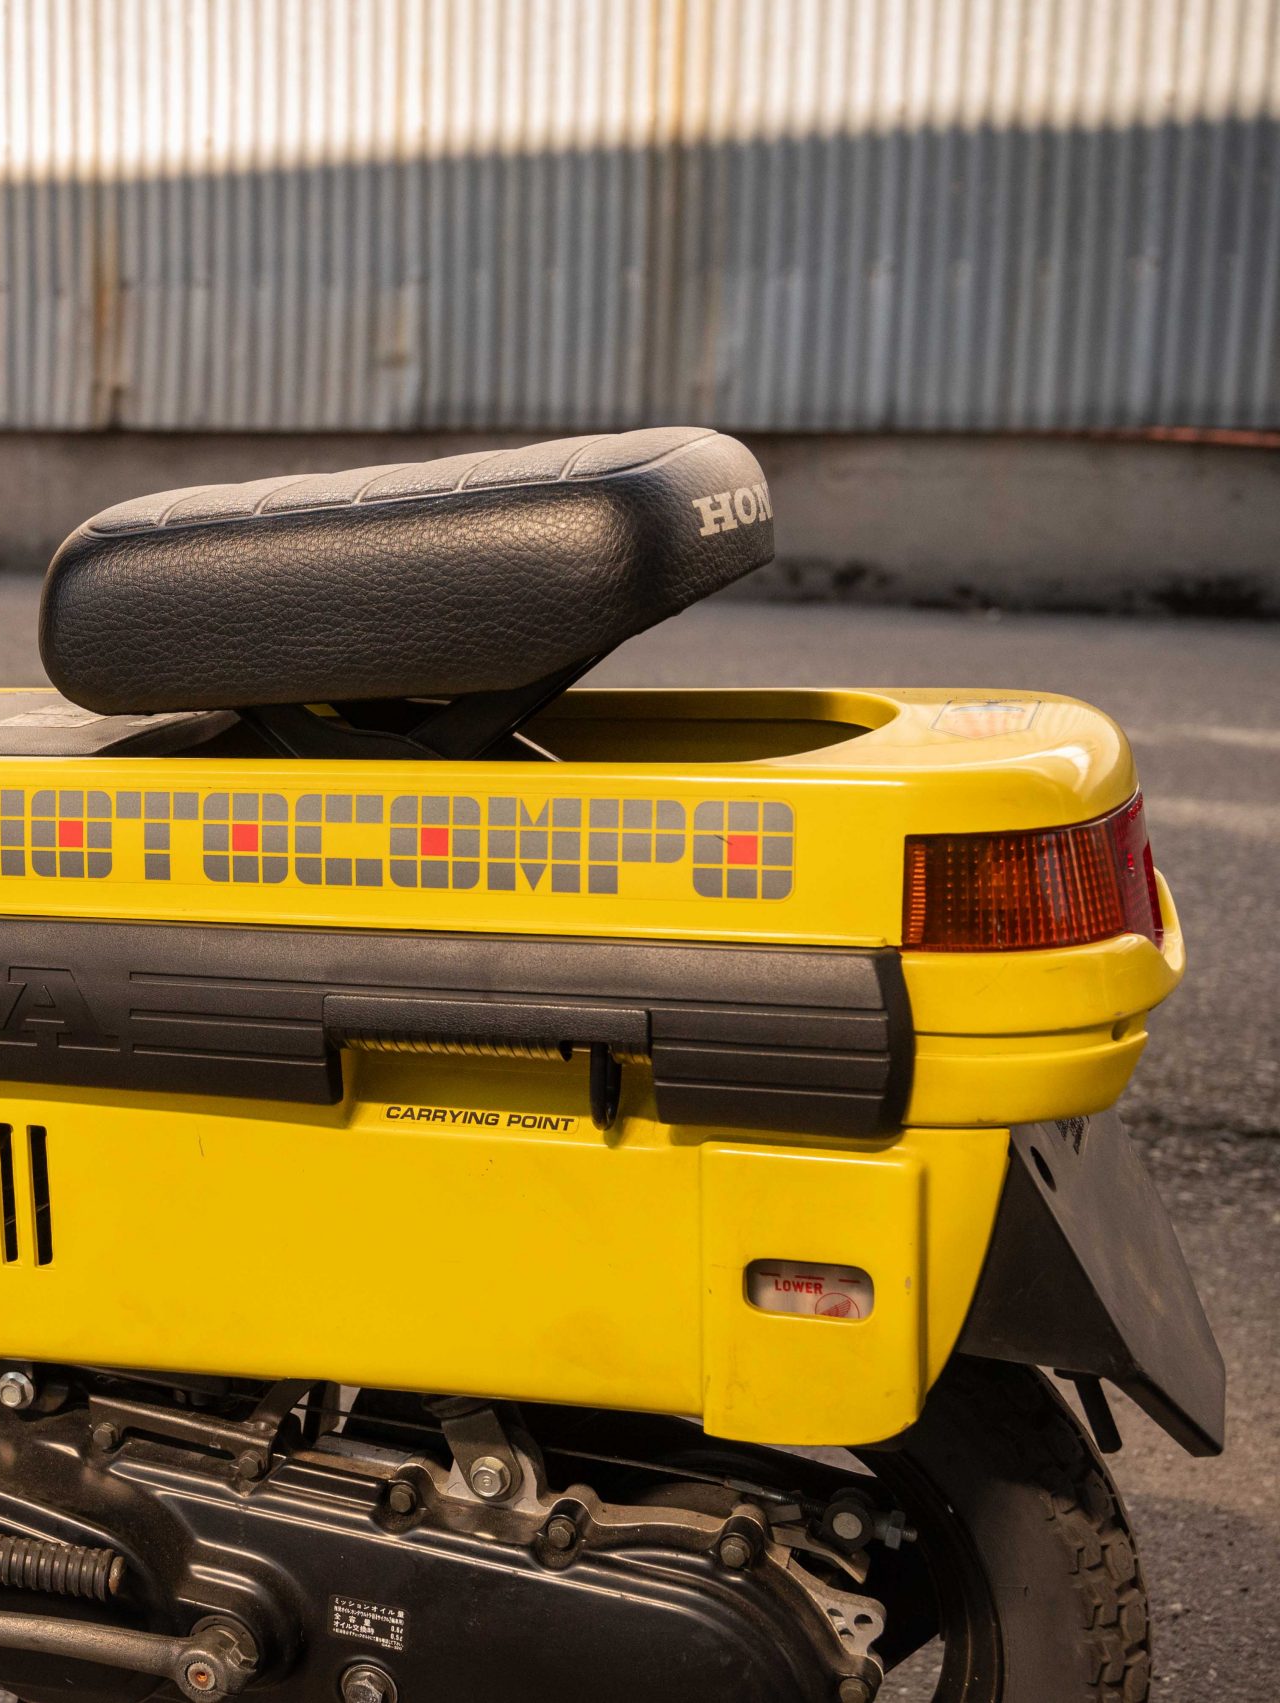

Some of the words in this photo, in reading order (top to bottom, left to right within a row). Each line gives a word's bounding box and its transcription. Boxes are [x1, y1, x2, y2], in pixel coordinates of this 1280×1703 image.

[386, 1106, 500, 1126] CARRYING
[506, 1114, 574, 1131] POINT
[774, 1279, 823, 1294] LOWER
